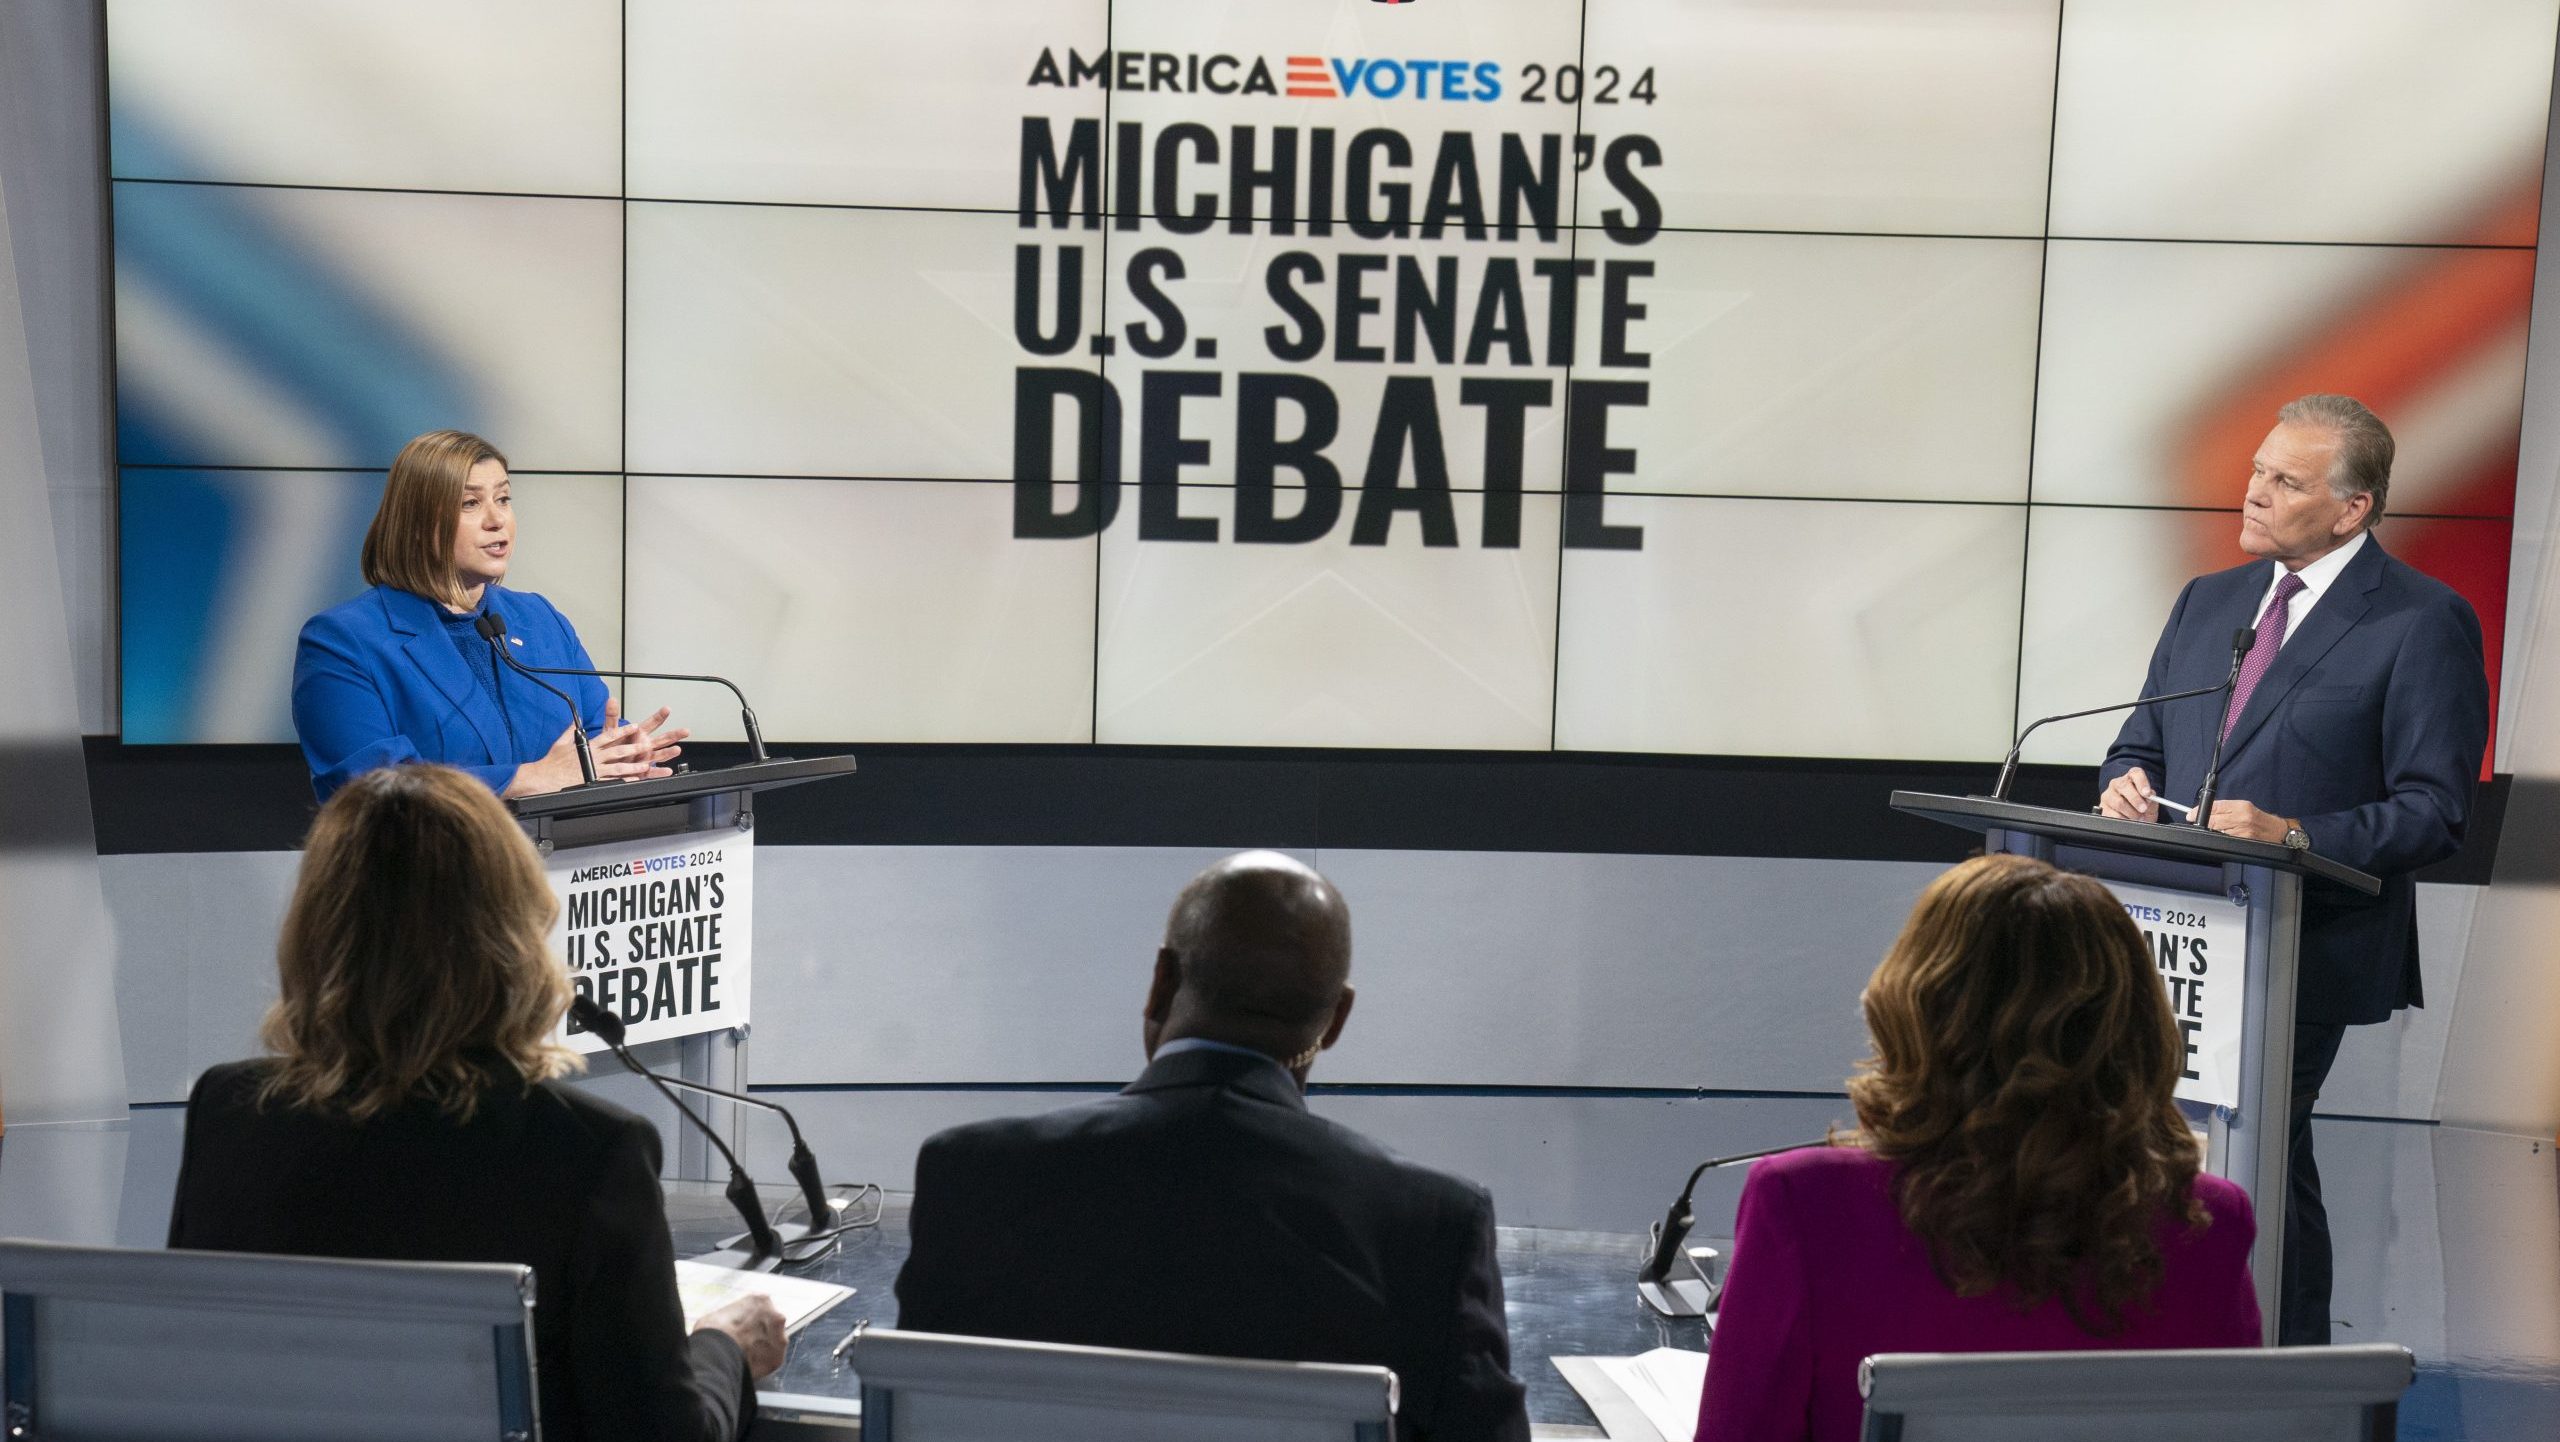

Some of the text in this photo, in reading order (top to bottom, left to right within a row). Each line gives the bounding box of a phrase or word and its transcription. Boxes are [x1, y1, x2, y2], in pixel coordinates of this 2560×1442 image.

[1027, 48, 1656, 105] AMERICA VOTES 2024
[1018, 117, 1663, 246] MICHIGAN'S
[1013, 244, 1655, 368] U.S. SENATE
[1013, 367, 1650, 551] DEBATE
[570, 851, 722, 884] AMERICA VOTES 2024
[568, 872, 725, 930] MICHIGAN'S
[2122, 903, 2207, 928] OTES 2024
[567, 914, 722, 971] U.S. SENATE
